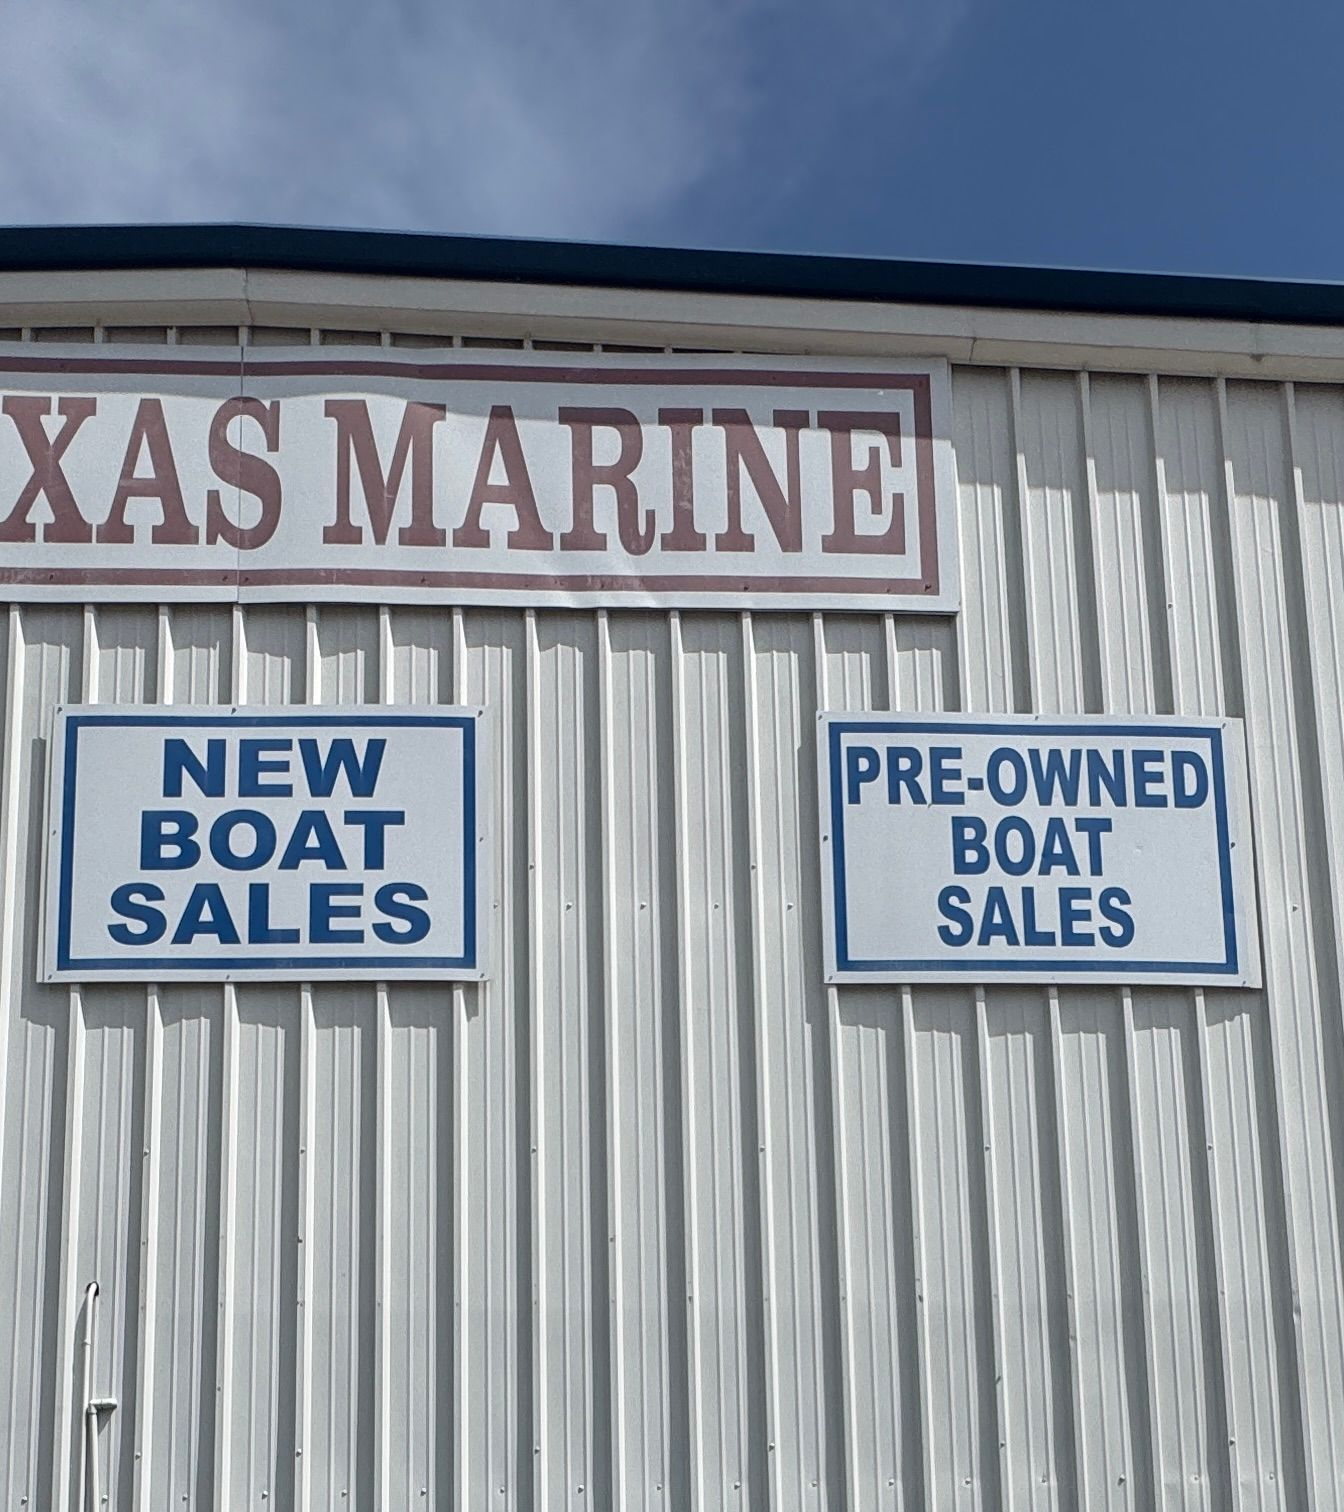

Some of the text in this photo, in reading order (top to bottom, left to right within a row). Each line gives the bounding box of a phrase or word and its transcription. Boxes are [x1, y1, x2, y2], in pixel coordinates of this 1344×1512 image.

[323, 396, 906, 555] MARINE
[162, 738, 388, 799] NEW
[845, 746, 1210, 810] PRE-OWNED
[139, 809, 406, 872] BOAT
[951, 815, 1113, 877] BOAT
[107, 882, 432, 946] SALES
[936, 884, 1136, 949] SALES
